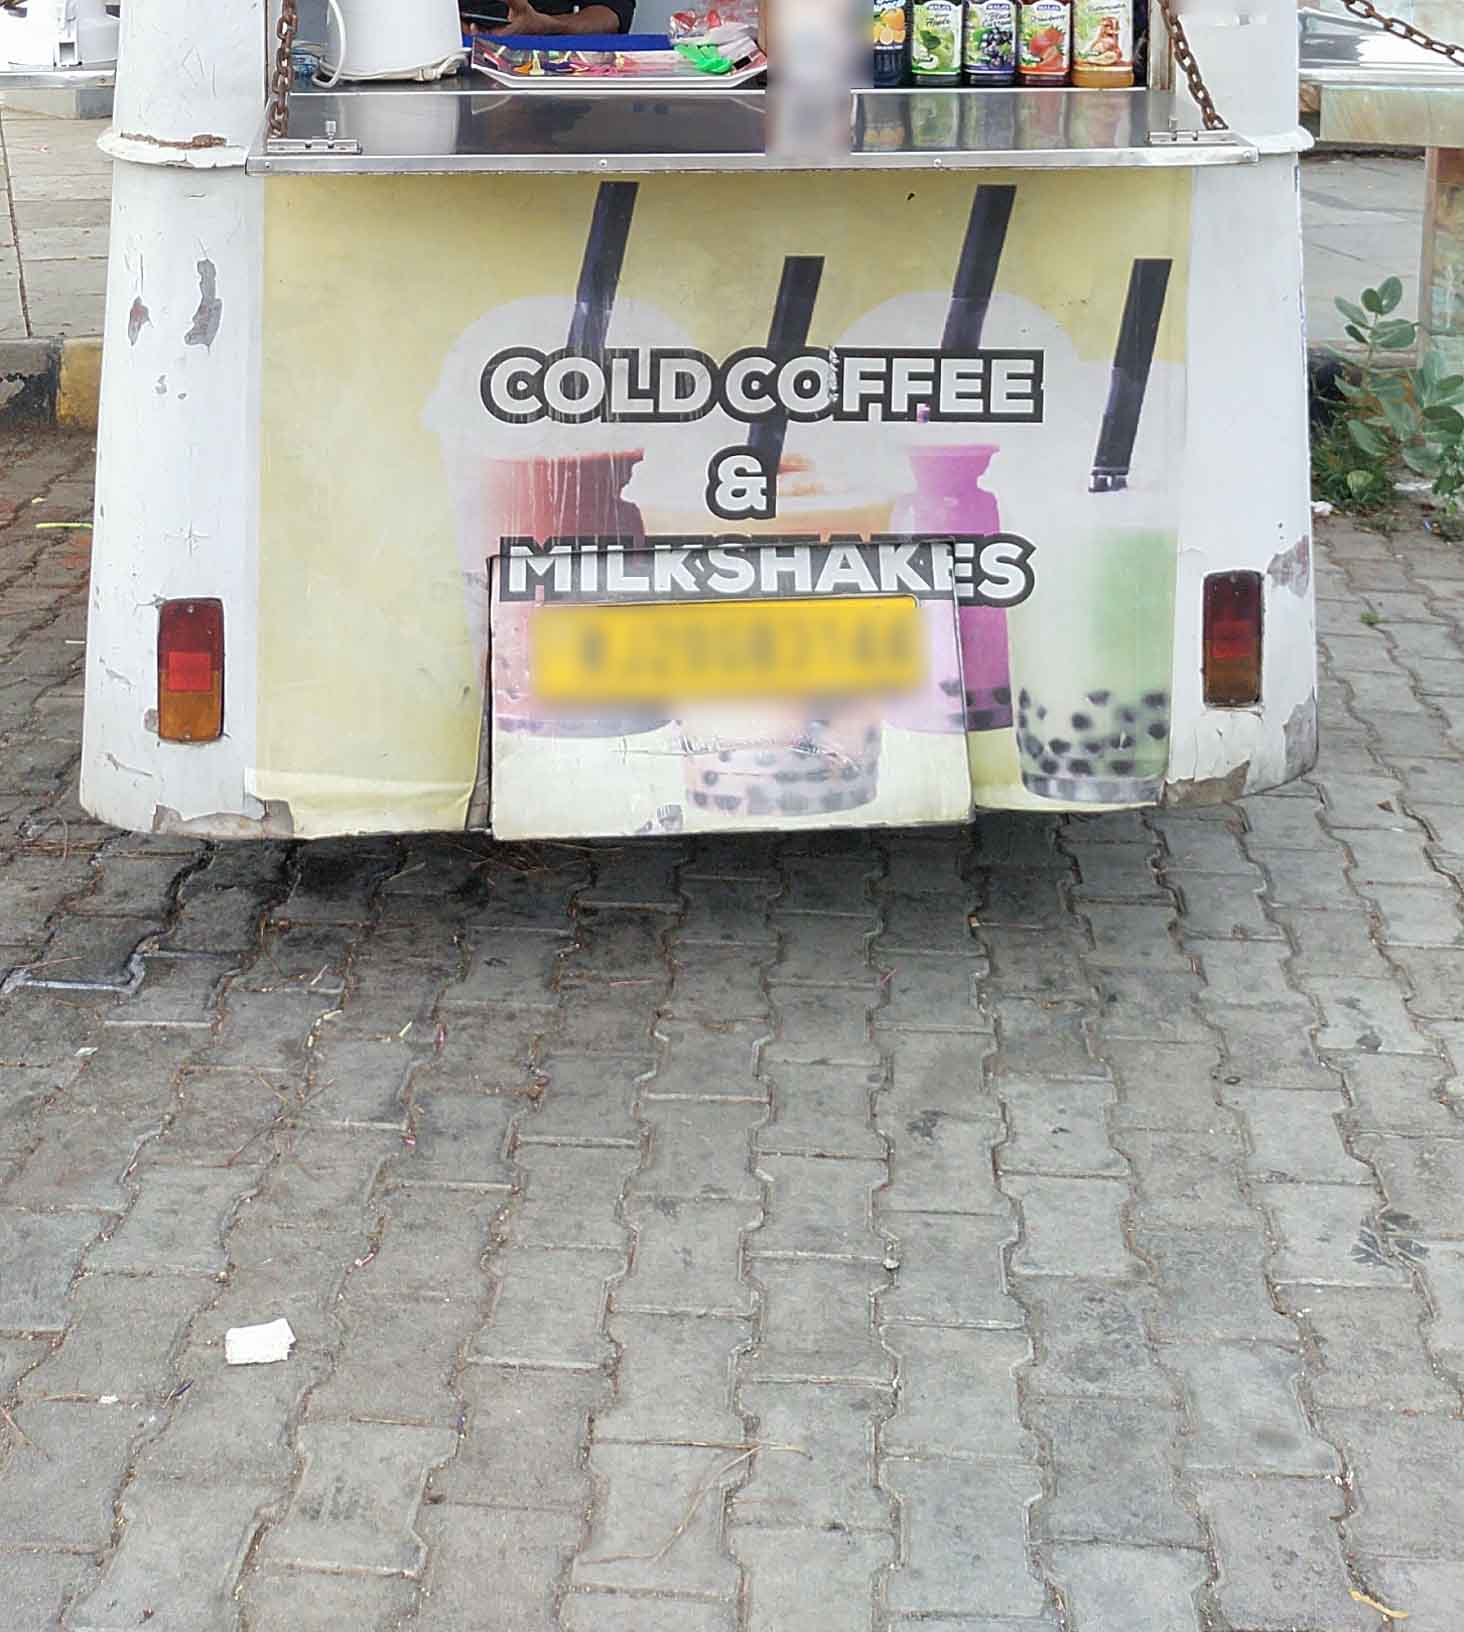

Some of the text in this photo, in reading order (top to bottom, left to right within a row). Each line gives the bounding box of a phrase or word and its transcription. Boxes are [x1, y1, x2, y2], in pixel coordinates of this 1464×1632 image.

[484, 350, 1042, 420] COLD COFFEE
[708, 447, 774, 518] &
[503, 537, 1034, 605] MILKSHAKES
